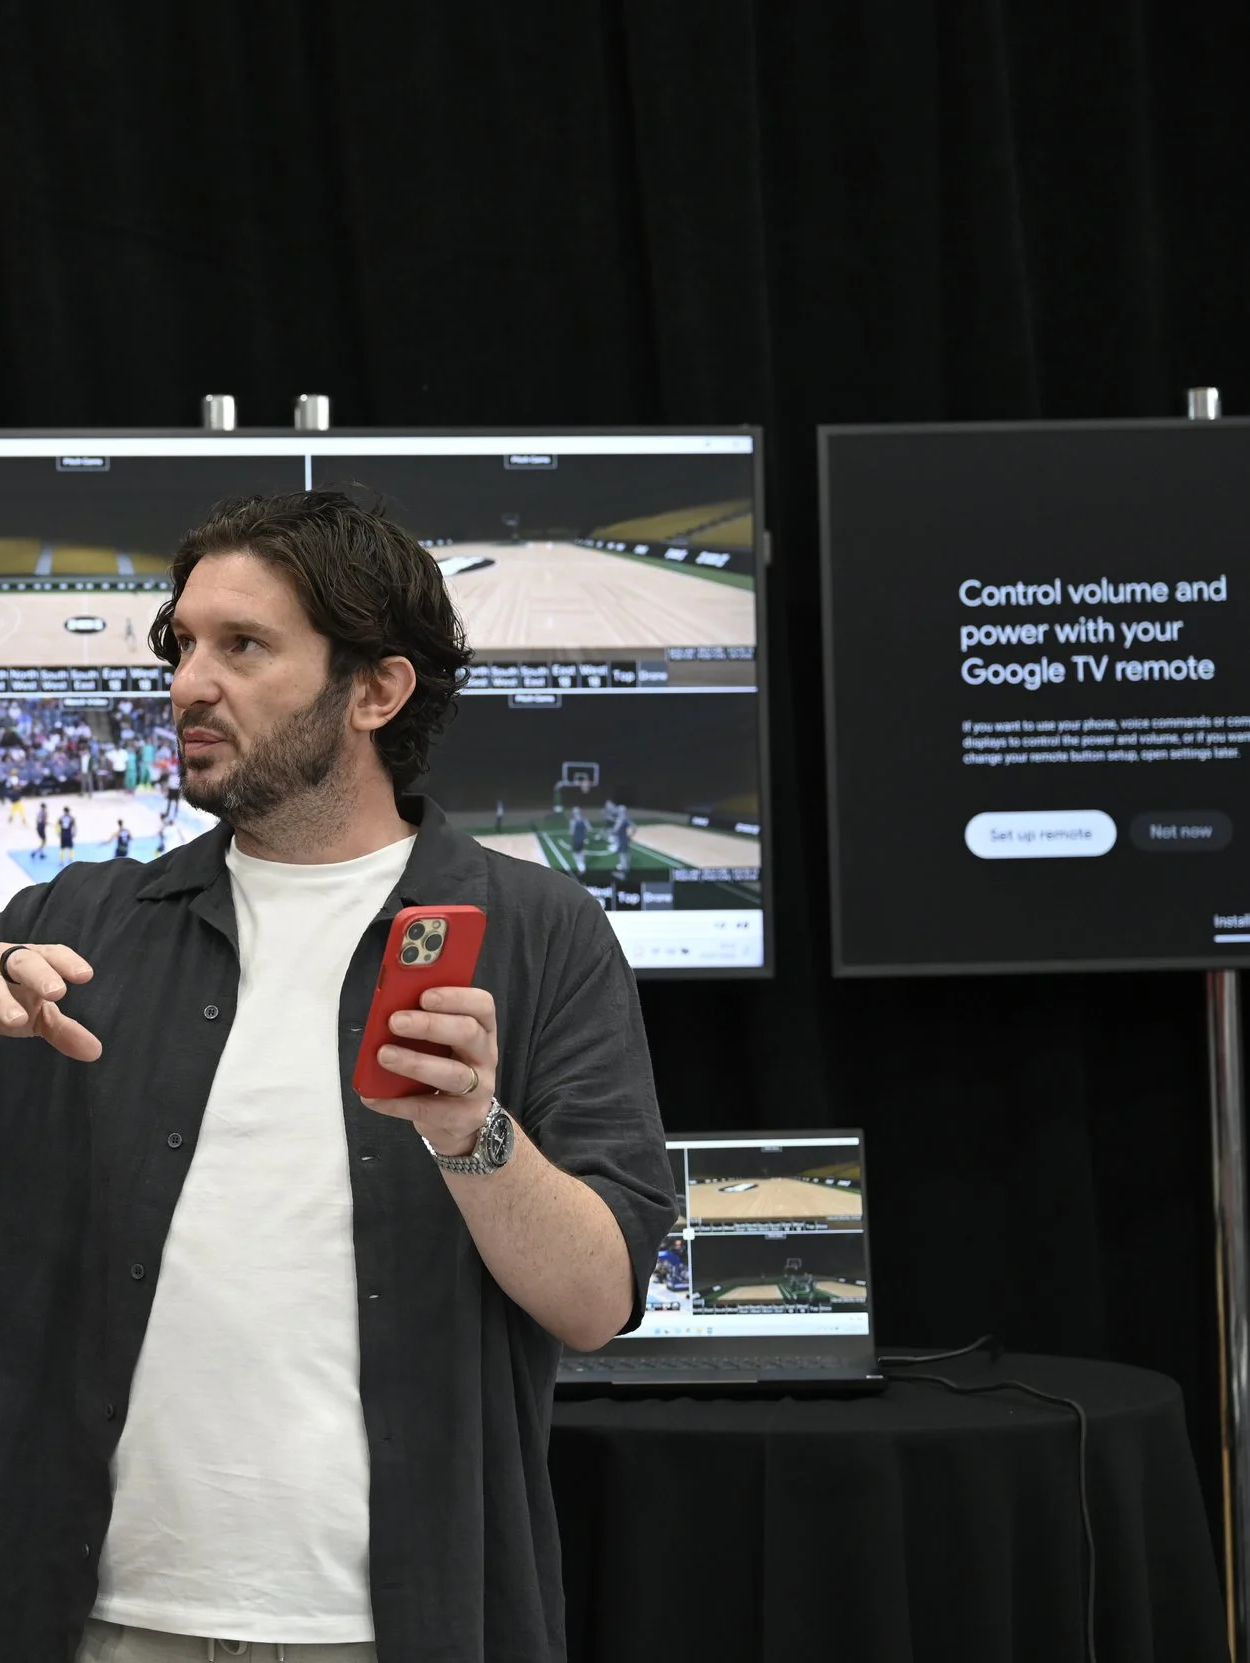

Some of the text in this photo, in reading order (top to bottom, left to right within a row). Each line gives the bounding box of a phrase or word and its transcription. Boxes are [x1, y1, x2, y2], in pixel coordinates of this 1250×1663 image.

[958, 574, 1228, 607] Control volume and
[960, 616, 1184, 653] power with your
[613, 669, 635, 682] Top
[961, 654, 1216, 691] Google TV remote
[1151, 715, 1211, 729] commands
[962, 735, 1008, 751] displays
[1022, 734, 1061, 748] control
[1081, 734, 1115, 748] power
[1116, 732, 1138, 745] and
[962, 751, 1003, 767] change
[1004, 752, 1029, 767] your
[1029, 751, 1069, 764] remote
[1069, 749, 1106, 763] button
[1140, 749, 1168, 763] open
[1169, 746, 1212, 762] settings
[989, 827, 1093, 845] Set up remote
[1150, 823, 1213, 840] Not now
[618, 891, 640, 904] Top
